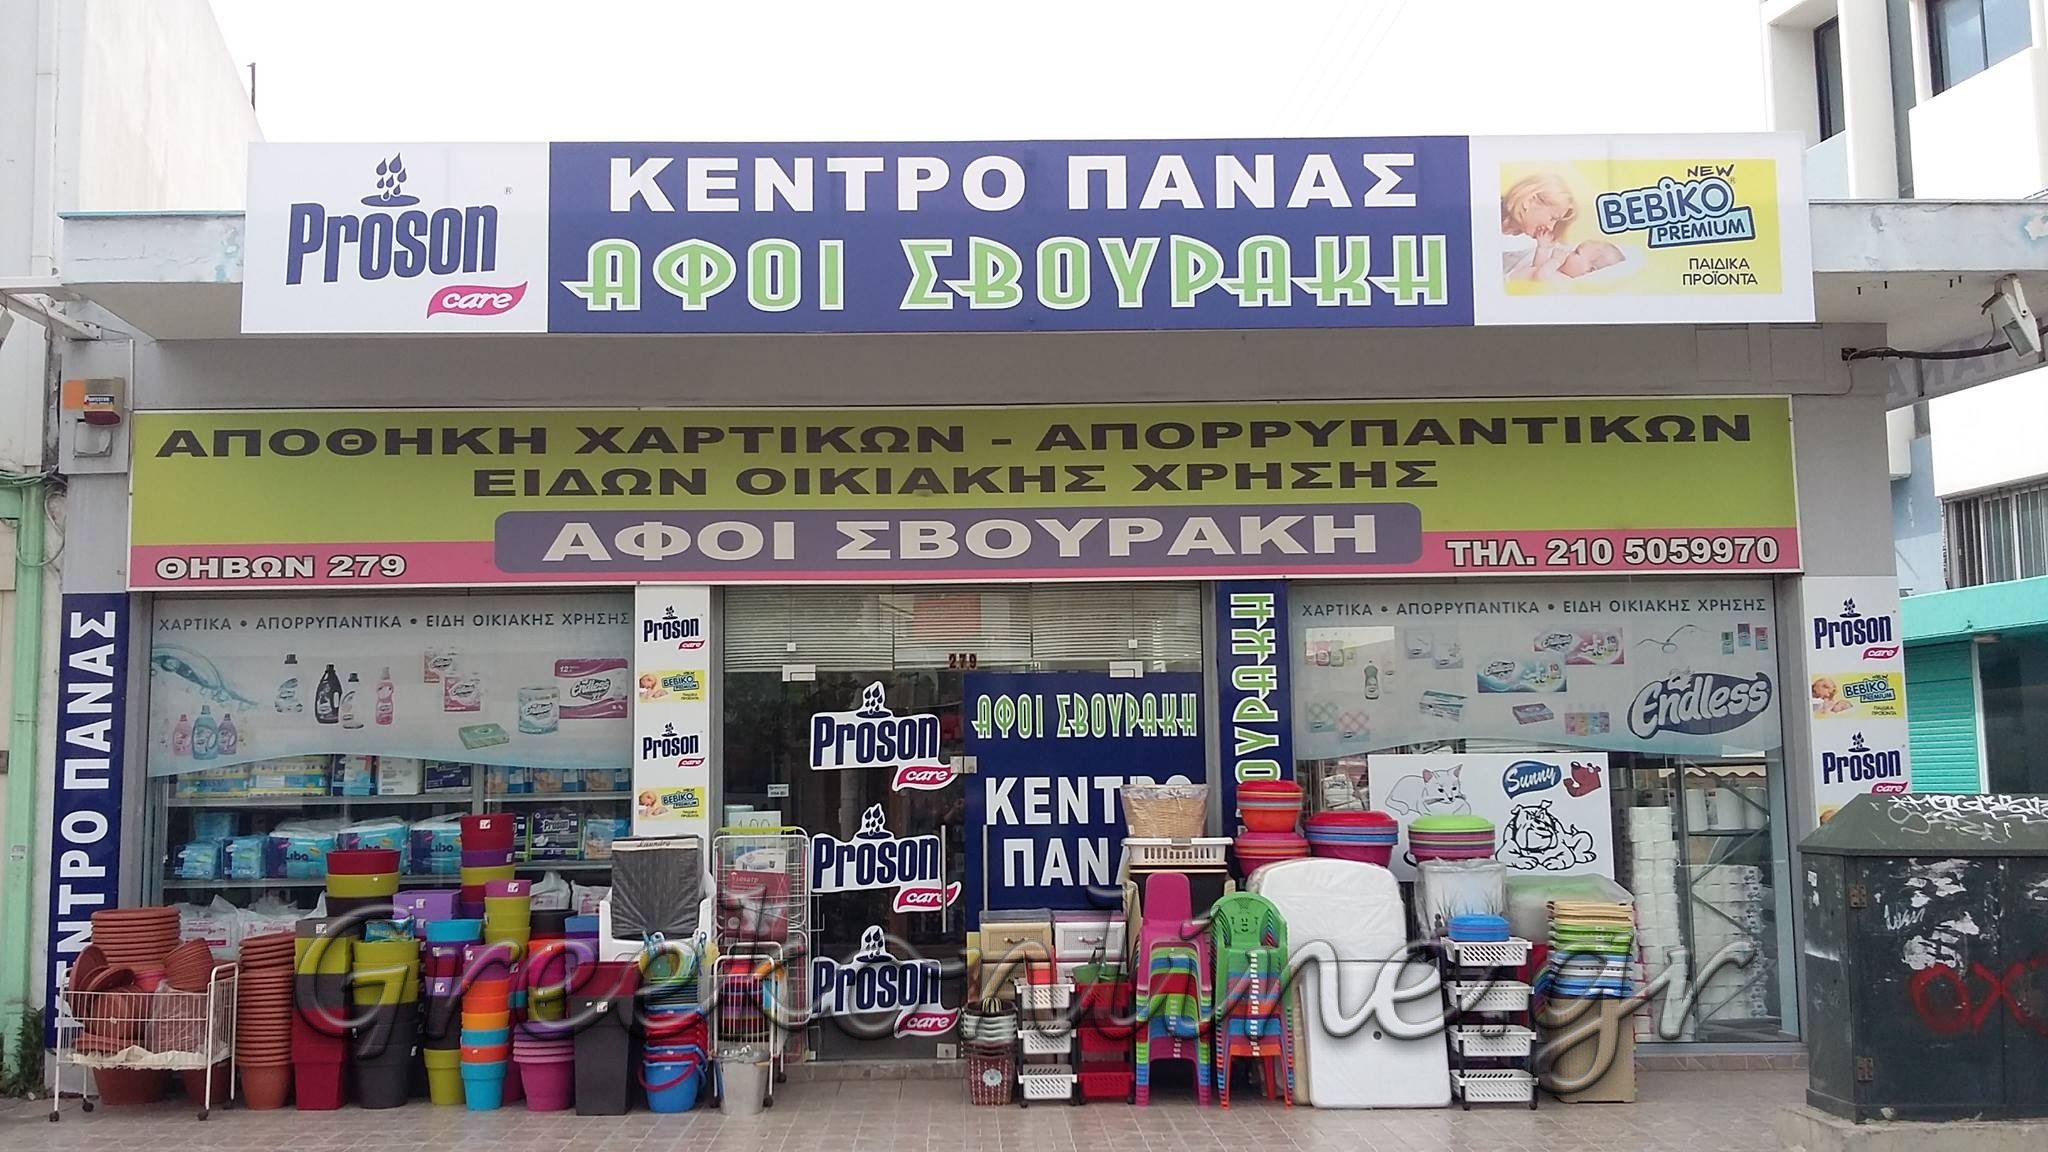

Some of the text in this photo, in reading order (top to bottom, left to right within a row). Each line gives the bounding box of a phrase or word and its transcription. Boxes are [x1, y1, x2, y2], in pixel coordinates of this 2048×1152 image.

[610, 153, 1416, 212] ΚΕΝΤΡΟ ΠΑΝΑΣ
[1687, 164, 1734, 177] NEW
[286, 203, 497, 285] Proson
[1657, 218, 1745, 242] PREMIUM
[560, 234, 1448, 312] ΑΦΟΙ ΣΒΟΥΡΑΚΗ
[1682, 271, 1758, 286] ΠΡΟΪΟΝΤΑ
[1689, 258, 1750, 270] ΠΑΙΔΙΚΑ
[441, 291, 513, 310] care
[155, 427, 546, 458] ΑΠΟΘΗΚΗ
[574, 425, 964, 455] ΧΑΡΤΙΚΩΝ
[1035, 414, 1751, 451] ΑΠΟΡΡΥΠΑΝΤΙΚΩΝ
[474, 460, 1438, 497] ΕΙΔΩΝ ΟΙΚΙΑΚΗΣ ΧΡΗΣΗΣ
[542, 514, 1377, 561] ΑΦΟΙ ΣΒΟΥΡΑΚΗ
[1446, 536, 1779, 567] ΤΗΛ. 210 5059970
[155, 555, 407, 581] ΘΗΒΩΝ 279
[159, 612, 630, 631] ΧΑΡΤΙΚΑ ΑΠΟΡΡΥΠΑΝΤΙΚΑ ΕΙΔΗ ΟΙΚΙΑΚΗΣ ΧΡΗΣΗΣ
[1302, 598, 1765, 616] ΧΑΡΤΙΚΑ ΑΠΟΡΡΥΠΑΝΤΙΚΑ ΕΙΔΗ ΟΙΚΙΑΚΗΣ ΧΡΗΣΗΣ
[643, 617, 699, 643] Proson
[1813, 615, 1892, 649] Proson
[949, 653, 977, 669] 279
[1867, 648, 1894, 658] care
[64, 611, 116, 790] ΠΑΝΑΣ
[971, 692, 1197, 739] ΑΦΟΙ ΣΒΟΥΡΑΚΗ
[1630, 674, 1770, 738] Endless
[642, 734, 699, 760] Proson
[813, 715, 938, 767] Proson
[905, 768, 948, 781] care
[1508, 766, 1555, 792] Sunny
[1822, 749, 1901, 785] Proson
[985, 775, 1193, 825] ΚΕΝΤ
[812, 836, 938, 889] Proson
[811, 960, 939, 1014] Proson
[906, 1014, 950, 1029] care
